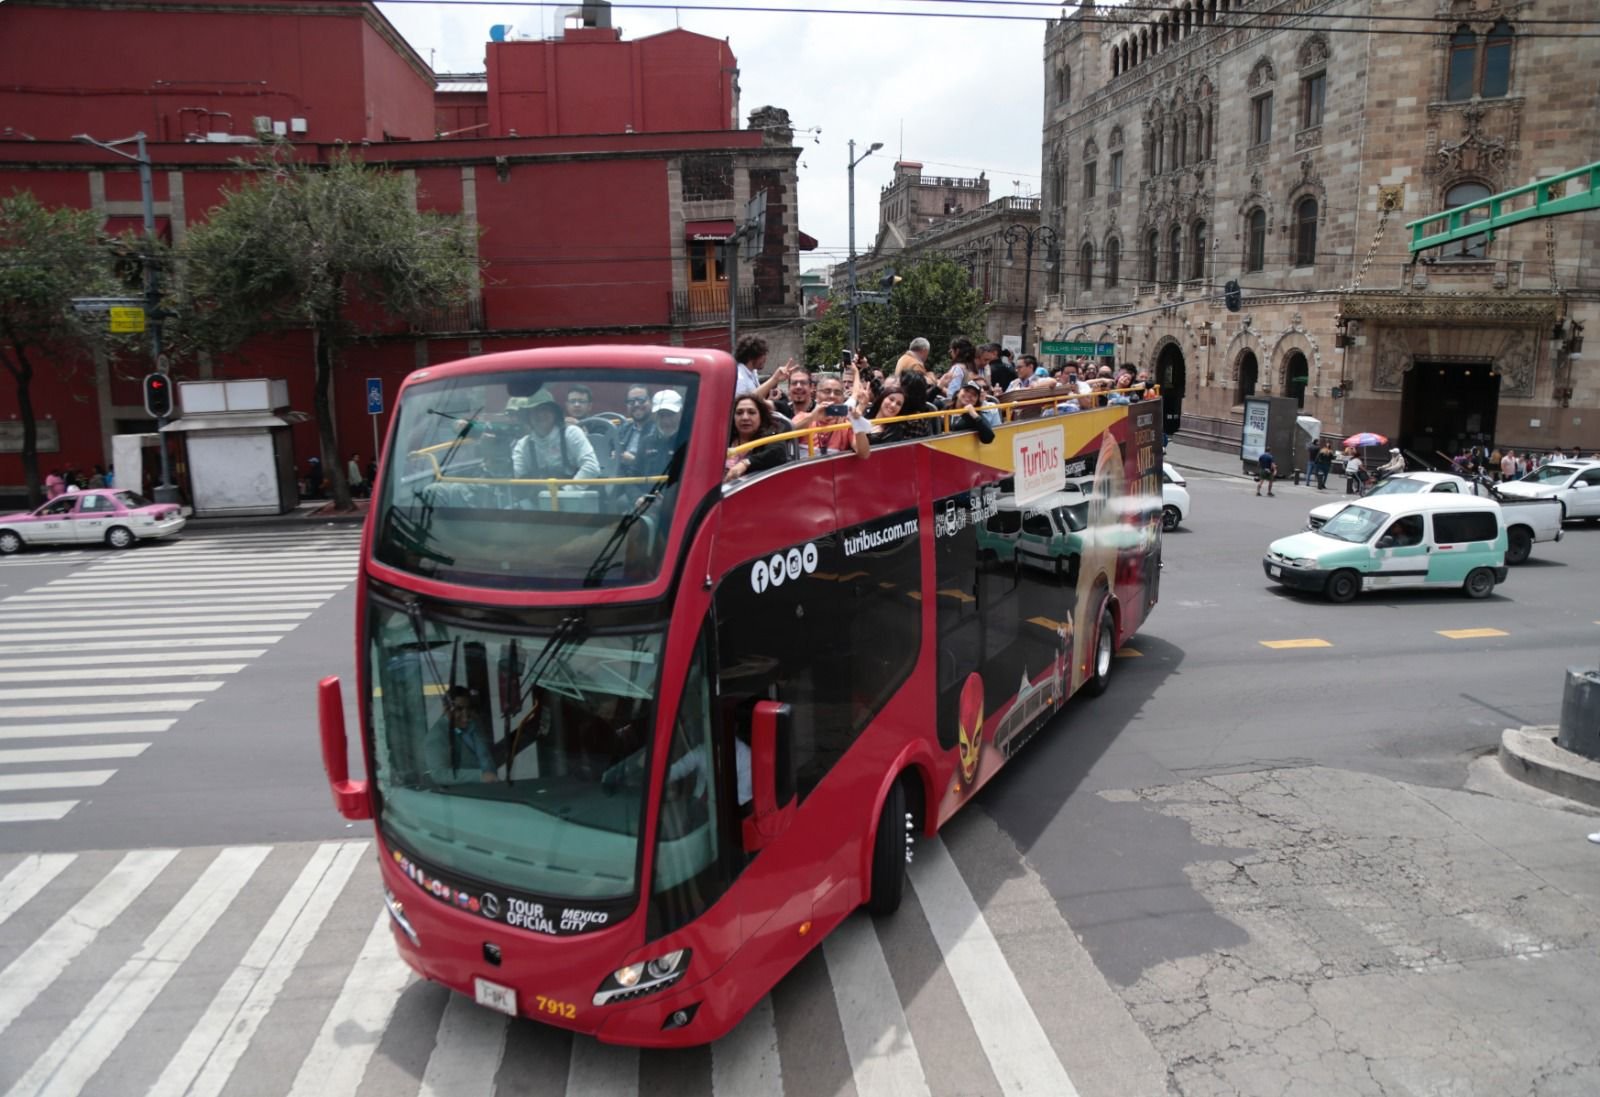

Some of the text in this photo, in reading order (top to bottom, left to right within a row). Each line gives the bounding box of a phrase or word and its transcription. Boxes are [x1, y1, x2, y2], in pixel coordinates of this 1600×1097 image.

[1020, 440, 1058, 478] Turibus
[844, 519, 918, 556] turibus.com.mx
[507, 897, 543, 919] TOUR
[561, 908, 608, 923] MEXICO
[507, 911, 557, 934] OFICIAL
[560, 919, 587, 931] CITY
[536, 995, 576, 1019] 7912
